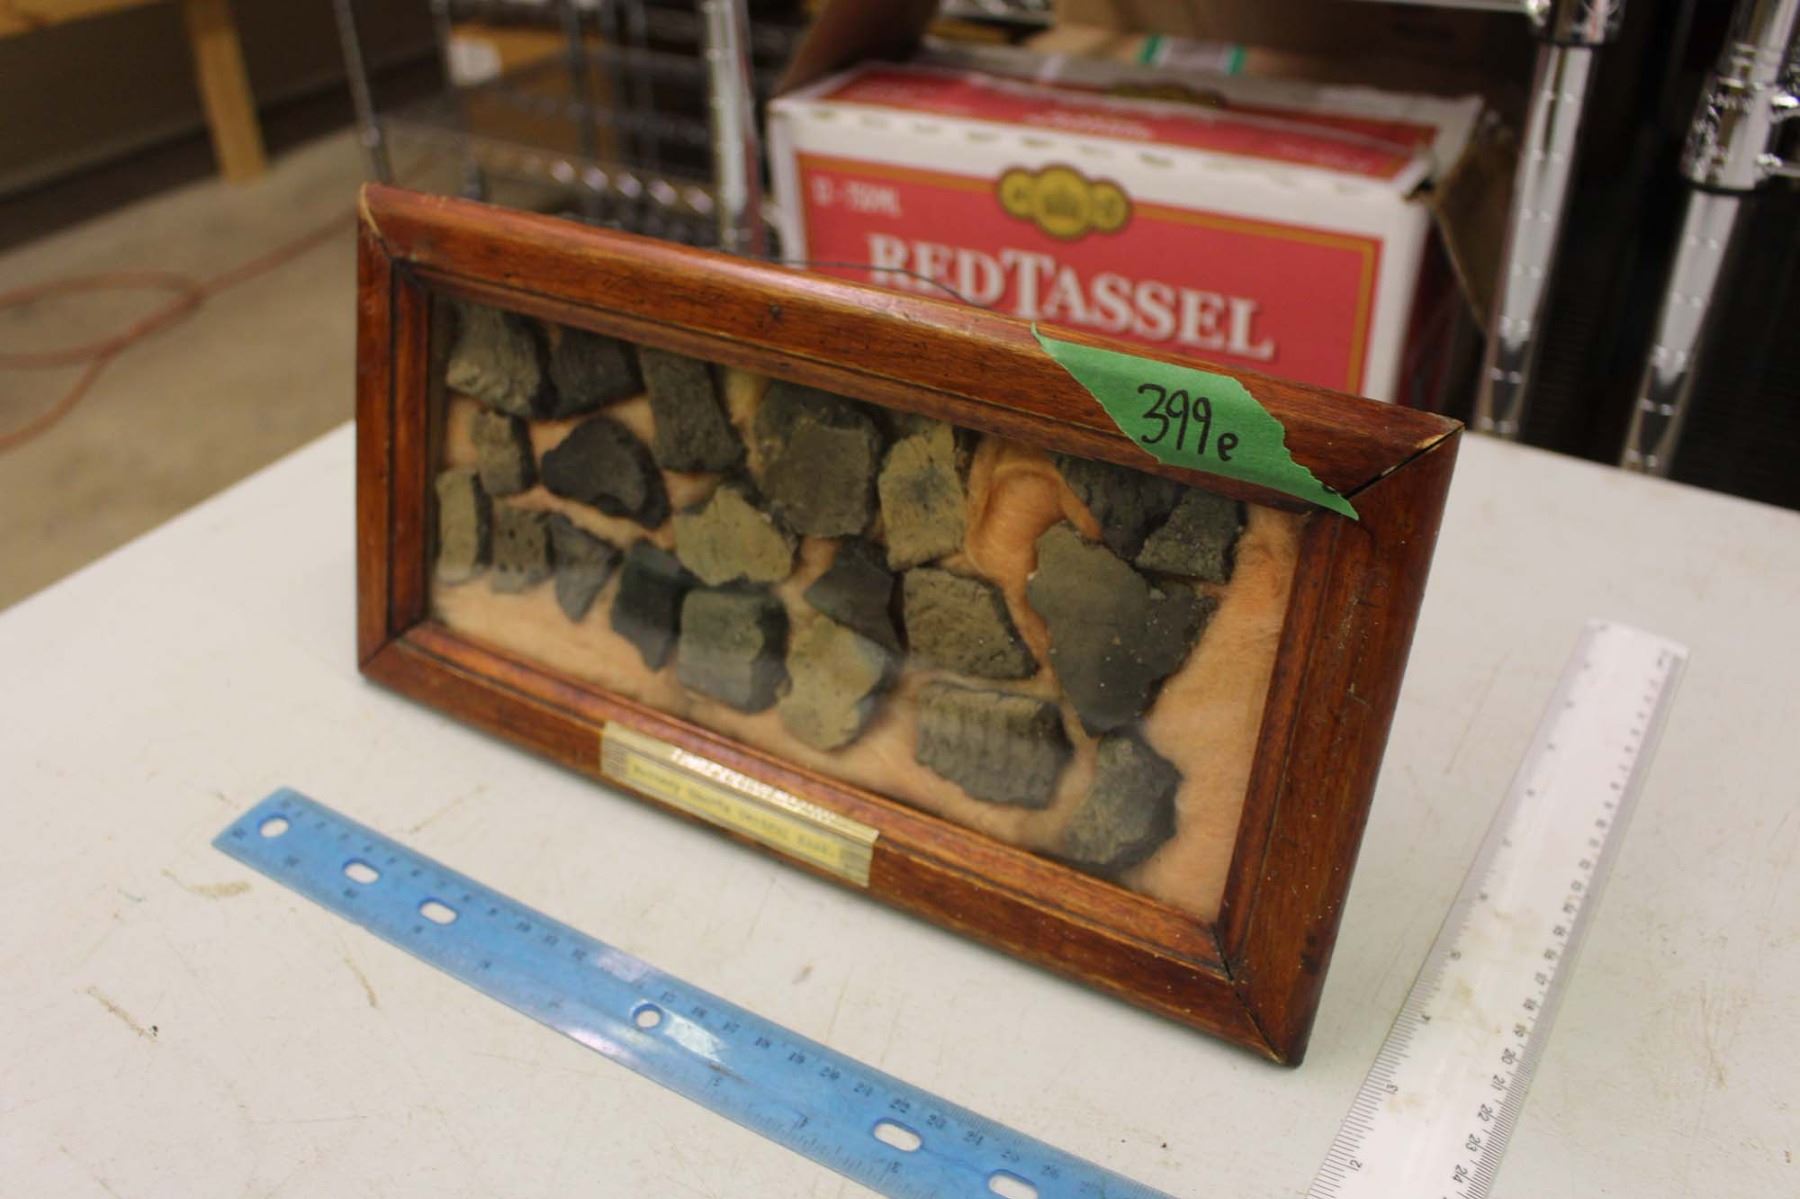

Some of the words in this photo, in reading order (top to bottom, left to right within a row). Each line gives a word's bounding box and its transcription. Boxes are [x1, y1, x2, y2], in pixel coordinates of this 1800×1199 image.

[1501, 1048, 1517, 1065] 20
[1490, 1074, 1506, 1091] 21
[889, 1098, 911, 1114] 22
[1477, 1103, 1493, 1122] 22
[1465, 1133, 1481, 1152] 23
[1351, 1158, 1363, 1171] 2
[1452, 1164, 1469, 1184] 24
